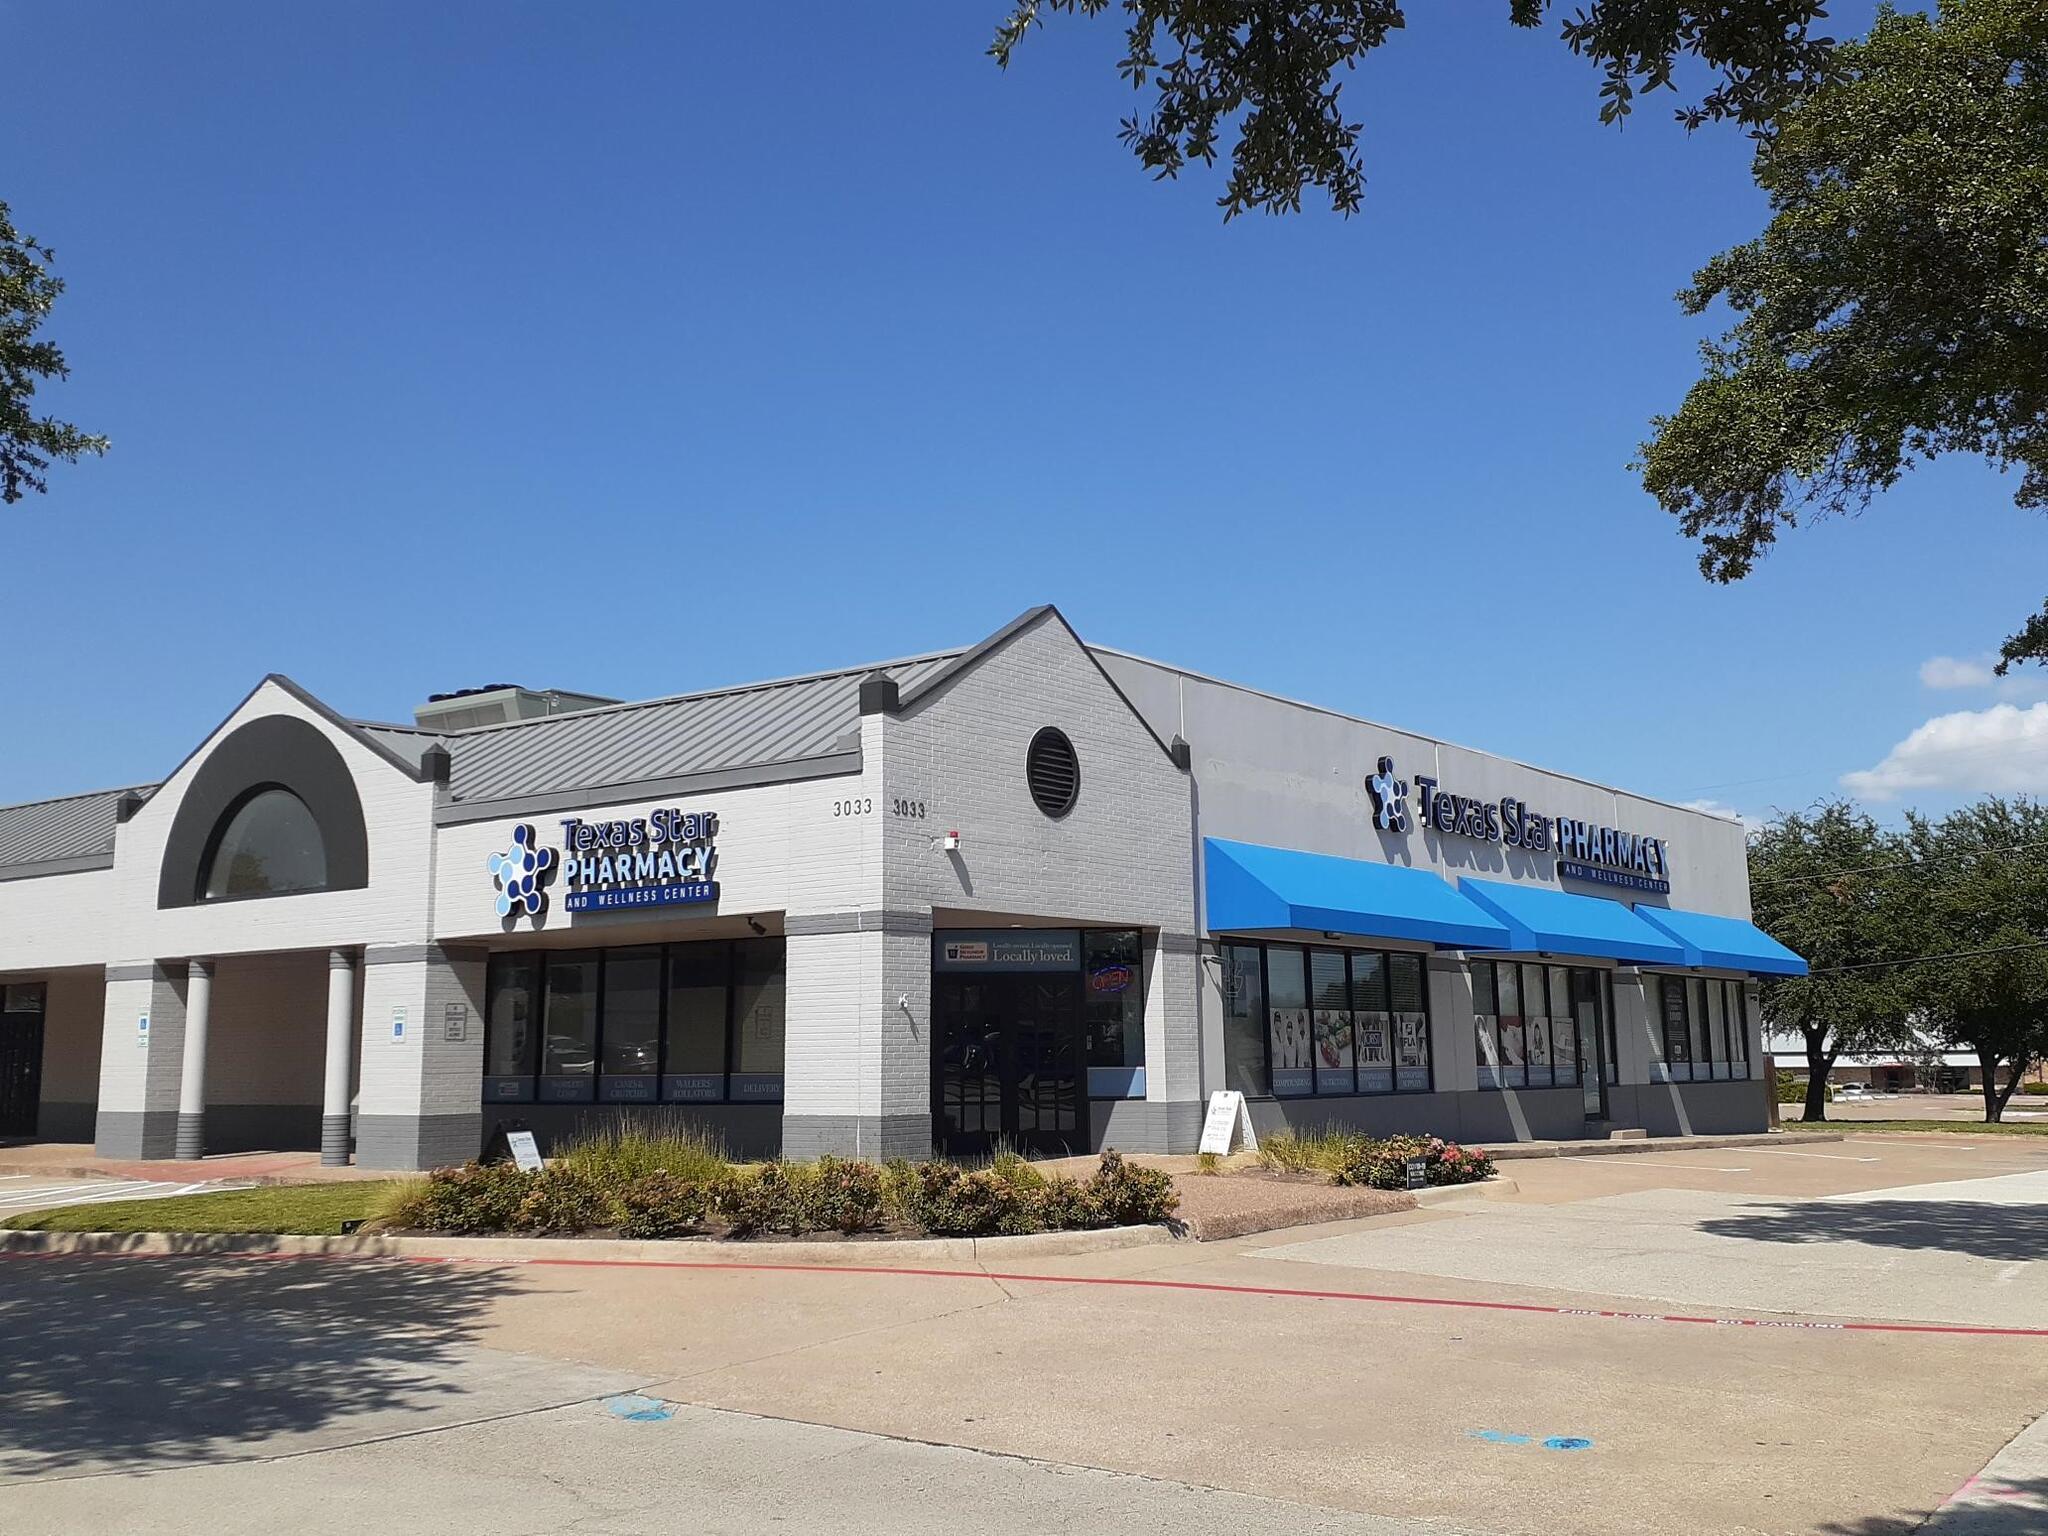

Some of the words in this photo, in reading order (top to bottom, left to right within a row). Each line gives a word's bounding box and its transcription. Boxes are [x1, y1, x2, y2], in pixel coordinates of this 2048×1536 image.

[833, 798, 872, 817] 3033
[893, 798, 925, 819] 3033
[560, 817, 646, 851] Texas
[650, 808, 717, 845] Star
[1415, 775, 1499, 842] Texas
[1501, 797, 1555, 852] Star
[1556, 817, 1668, 875] PHARMACY
[564, 846, 715, 886] PHARMACY
[1565, 864, 1583, 878] AND
[1591, 868, 1635, 888] WELLNESS
[1637, 877, 1669, 893] CENTER
[567, 896, 588, 909] AND
[598, 889, 656, 905] WELLNESS
[664, 885, 710, 900] CENTER
[993, 949, 1036, 965] Locally
[1039, 949, 1073, 961] loved.
[1092, 969, 1128, 989] OPEN
[743, 1083, 780, 1093] DELIVERY
[1755, 1321, 1844, 1329] PARKING
